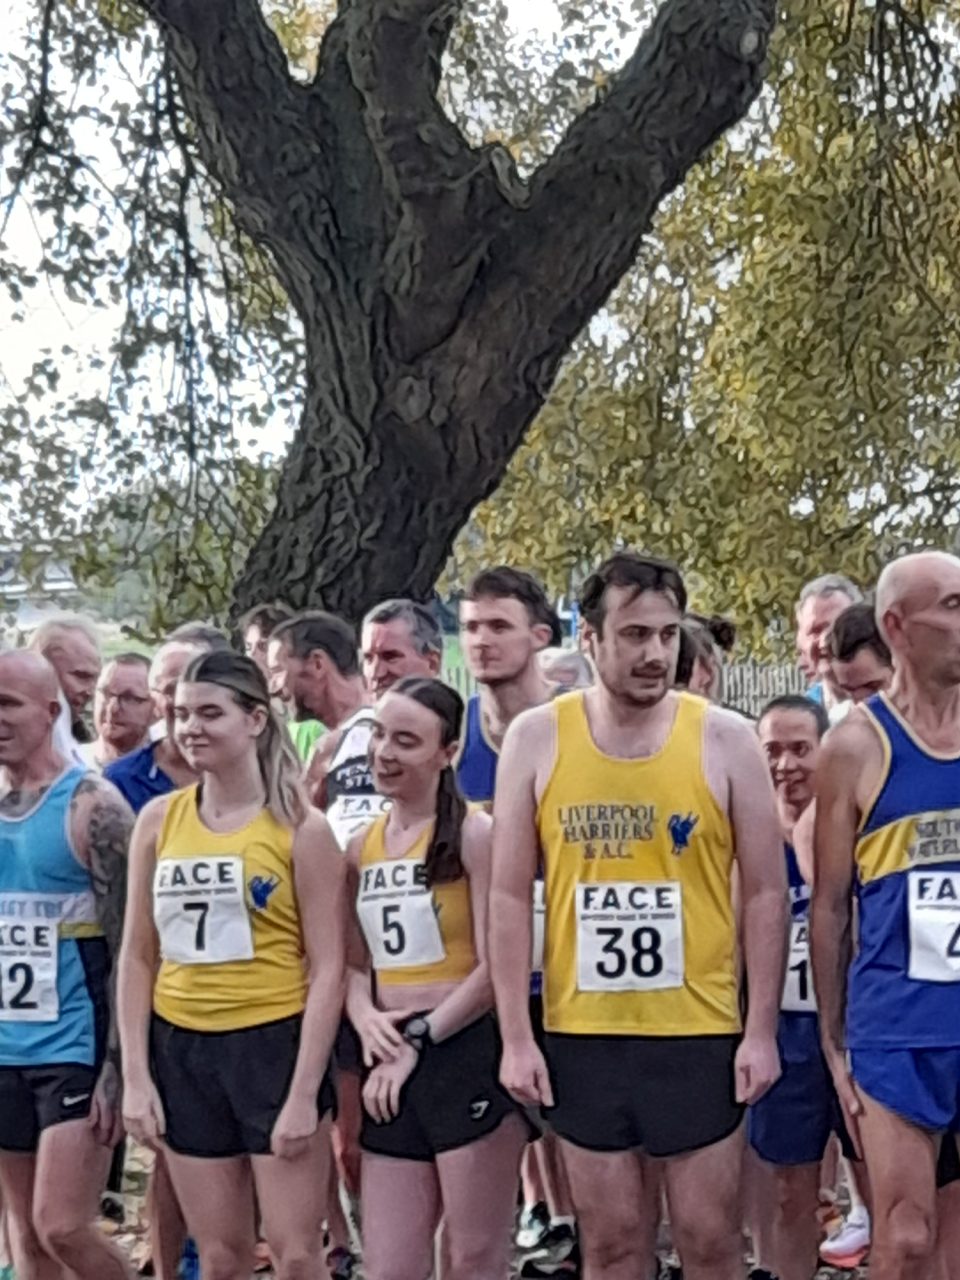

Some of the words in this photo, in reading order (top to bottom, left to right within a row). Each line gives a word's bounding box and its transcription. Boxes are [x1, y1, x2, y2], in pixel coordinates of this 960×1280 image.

[558, 805, 658, 825] LIVERPOOL
[564, 823, 654, 843] HARRIERS
[183, 902, 209, 951] 7
[382, 905, 406, 956] 5
[596, 926, 663, 979] 38
